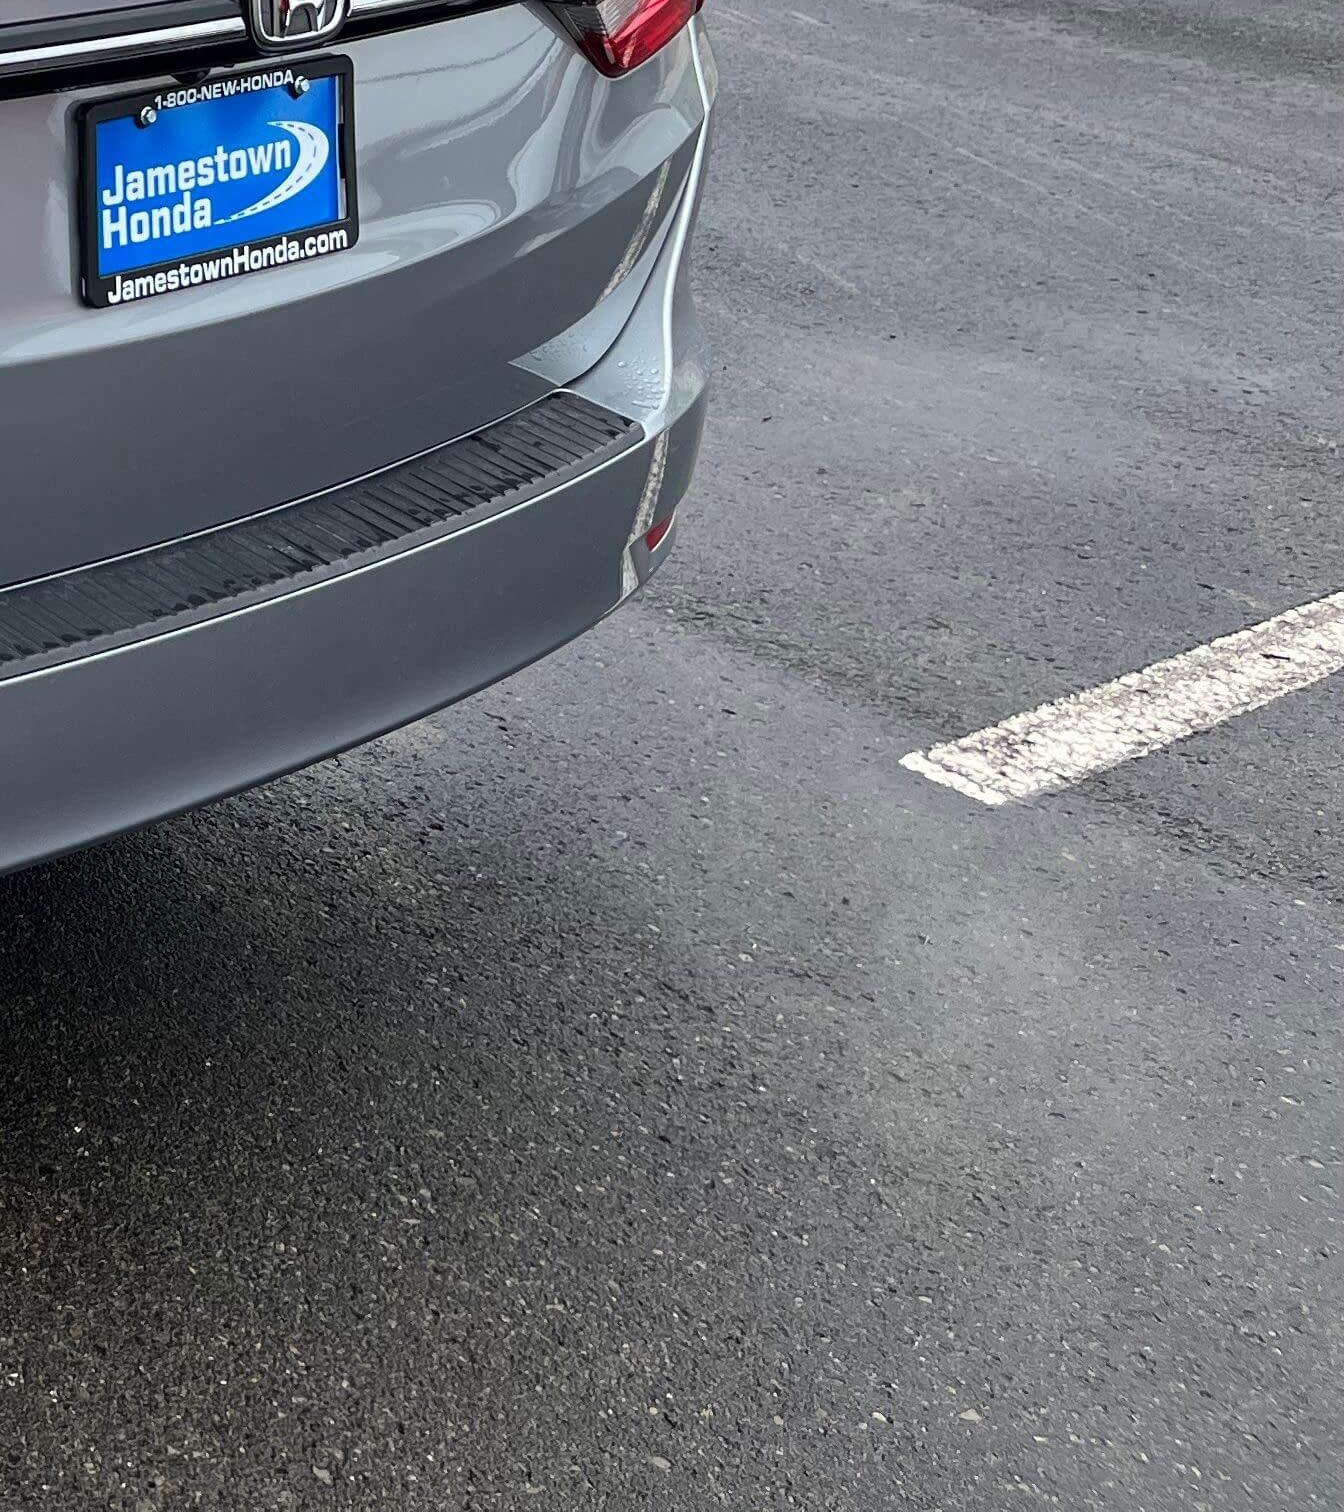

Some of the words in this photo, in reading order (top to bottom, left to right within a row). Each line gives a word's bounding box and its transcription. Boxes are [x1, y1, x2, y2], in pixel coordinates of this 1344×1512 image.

[154, 69, 294, 111] 1-800-NEW-HONDA
[101, 139, 292, 206] Jamestown
[101, 190, 213, 249] Honda
[108, 228, 349, 305] JamestownHonda.com
